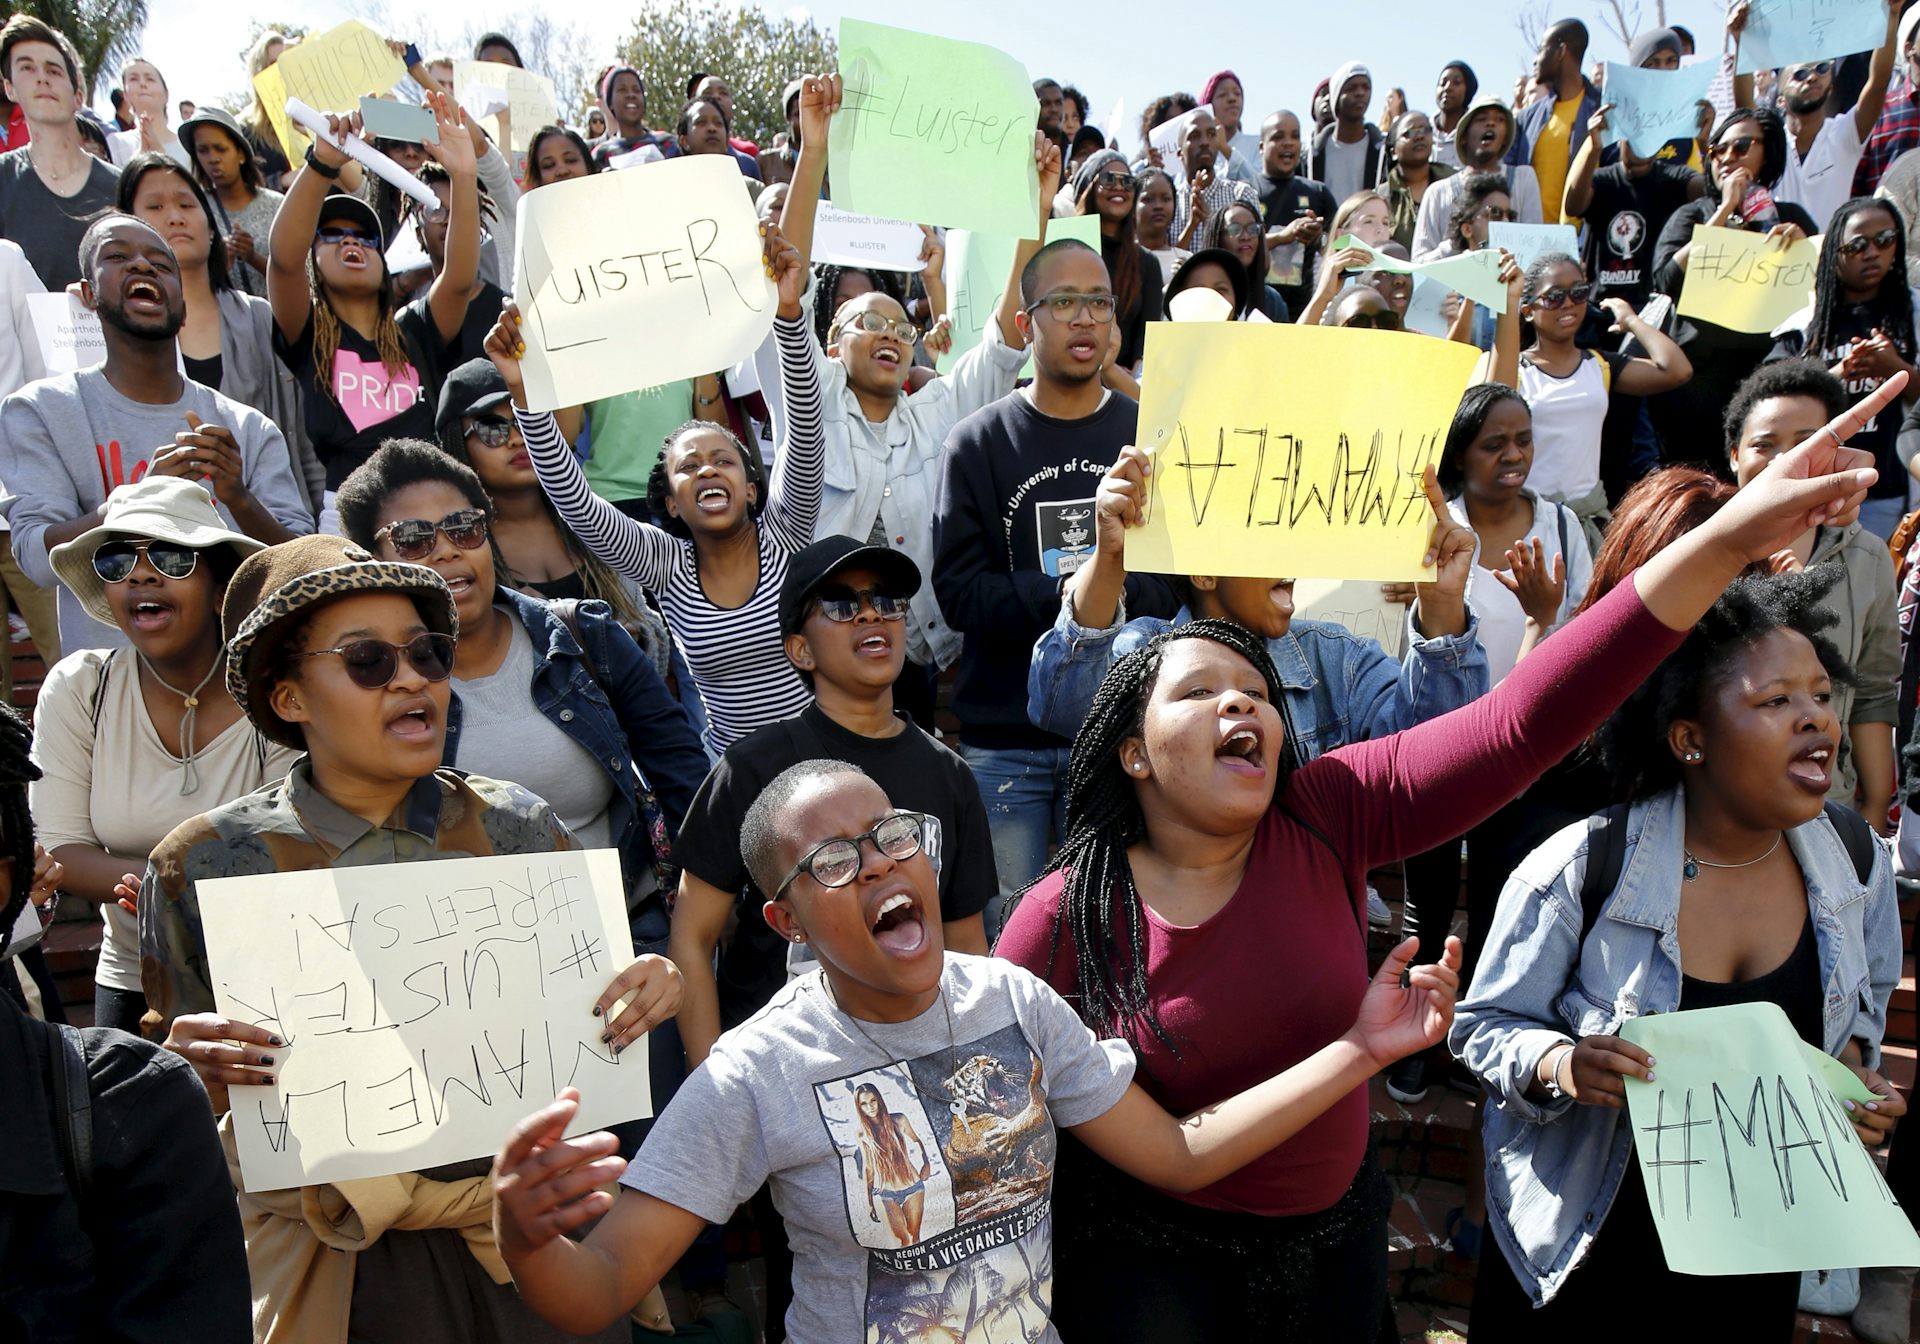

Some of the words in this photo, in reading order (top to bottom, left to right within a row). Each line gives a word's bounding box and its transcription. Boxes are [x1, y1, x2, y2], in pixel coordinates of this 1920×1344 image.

[840, 71, 1026, 156] #Luister
[819, 212, 871, 225] Stellenbosch
[521, 217, 763, 353] LUISTER
[1600, 269, 1641, 283] SUNDAY
[1007, 465, 1060, 510] University
[1063, 457, 1078, 473] of
[1080, 459, 1113, 477] Cape
[258, 1011, 620, 1153] MAMELA
[893, 1258, 914, 1271] DE
[917, 1253, 939, 1270] LA
[940, 1241, 967, 1265] VIE
[965, 1227, 1005, 1255] DANS
[1008, 1219, 1025, 1240] LE
